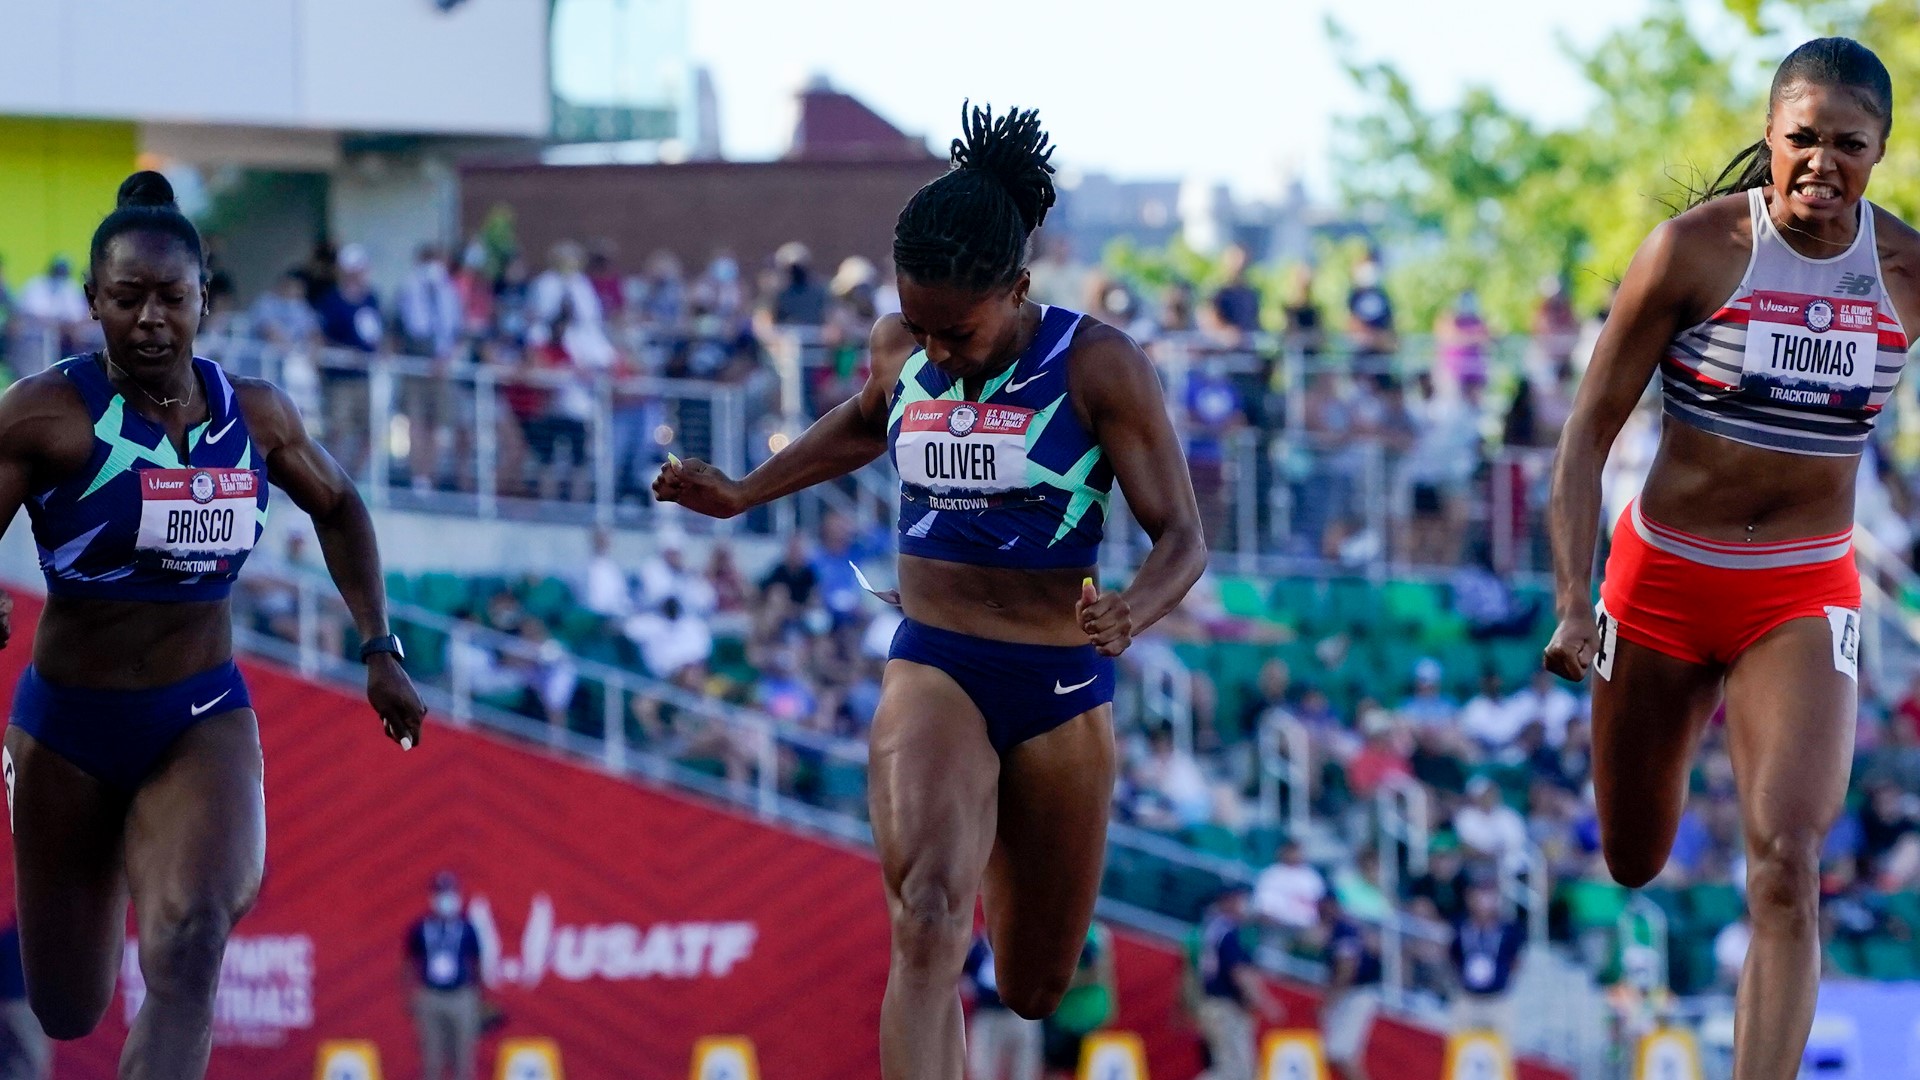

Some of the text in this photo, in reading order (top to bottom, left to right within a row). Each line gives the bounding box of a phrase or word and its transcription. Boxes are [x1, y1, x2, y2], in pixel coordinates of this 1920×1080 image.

[1771, 304, 1799, 314] USATF
[1840, 304, 1850, 314] U.S.
[1850, 305, 1873, 316] OLYMPIC
[1840, 314, 1854, 324] TEAM
[1855, 315, 1872, 326] TRIALS
[1771, 333, 1857, 377] THOMAS
[920, 412, 943, 420] USATF
[986, 409, 998, 418] U.S.
[1000, 410, 1027, 422] OLYMPIC
[983, 417, 1000, 426] TEAM
[1002, 419, 1024, 428] TRIALS
[925, 441, 997, 481] OLIVER
[230, 473, 253, 483] OLYMPIC
[160, 481, 184, 489] USATF
[220, 481, 253, 491] TEAM TRIALS
[166, 508, 234, 544] BRISCO
[553, 922, 758, 979] USATF
